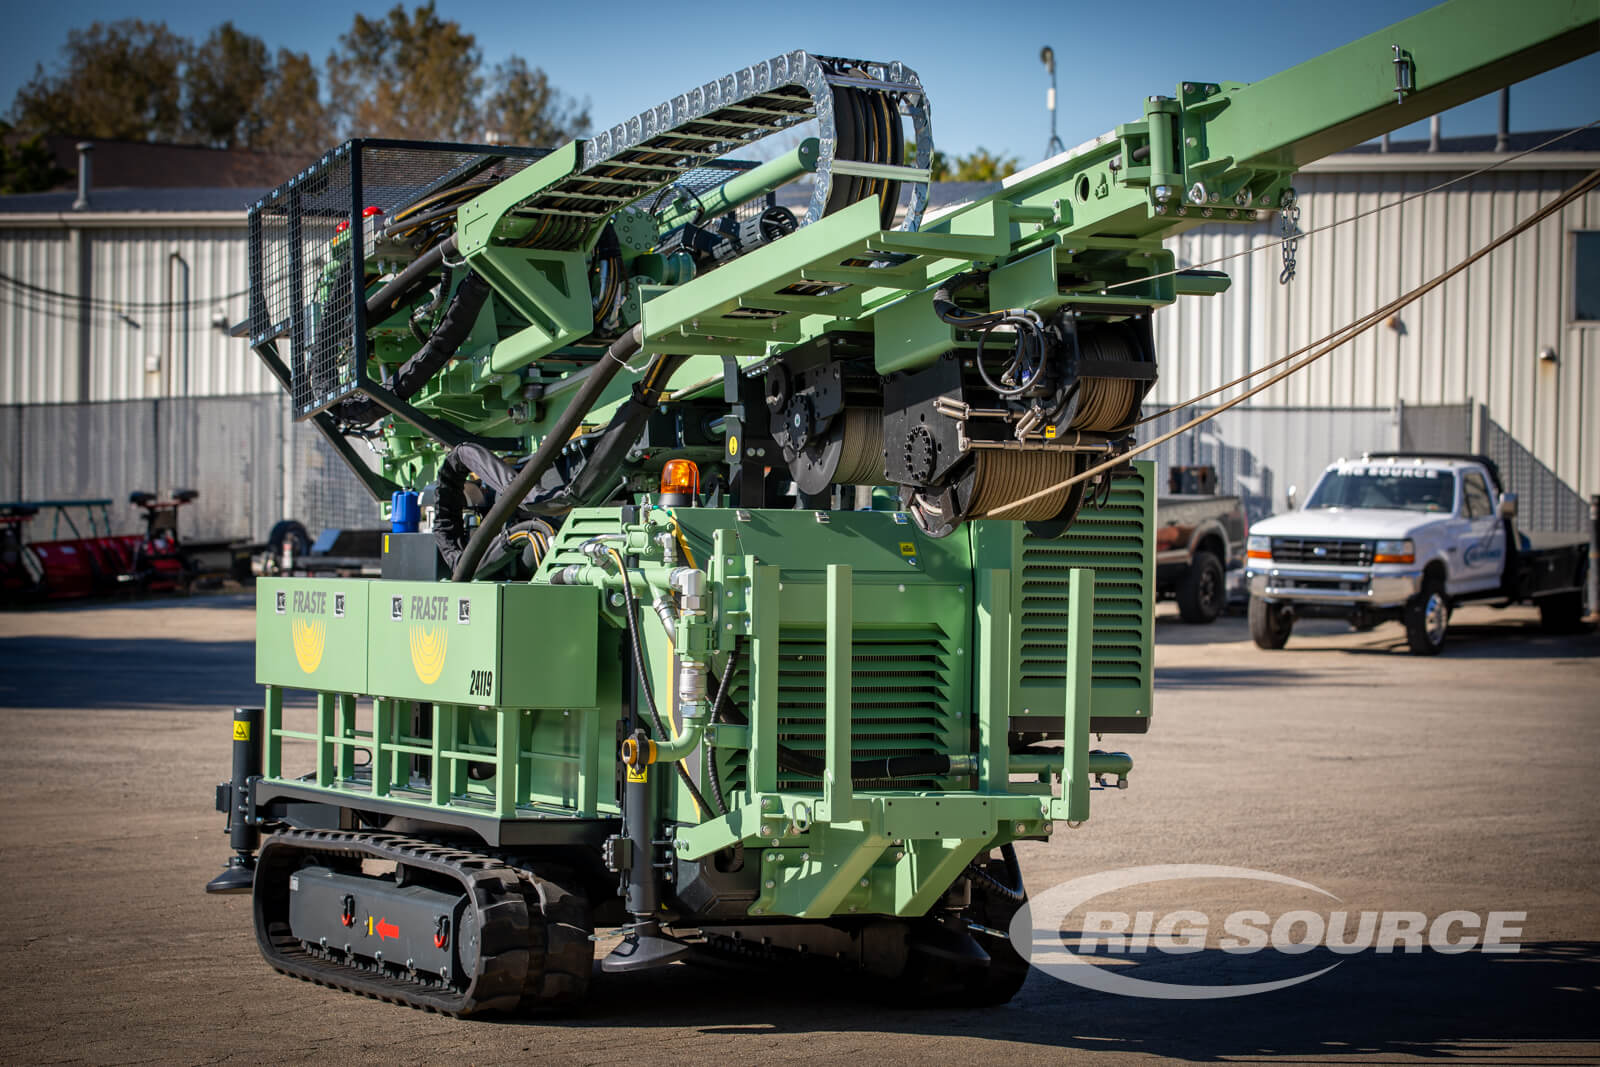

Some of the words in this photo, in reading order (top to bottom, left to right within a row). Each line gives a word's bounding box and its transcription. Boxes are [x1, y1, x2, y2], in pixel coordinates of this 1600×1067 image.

[1368, 467, 1437, 478] SOURCE
[292, 590, 327, 614] FRASTE
[410, 596, 449, 621] FRASTE
[469, 670, 493, 697] 24119
